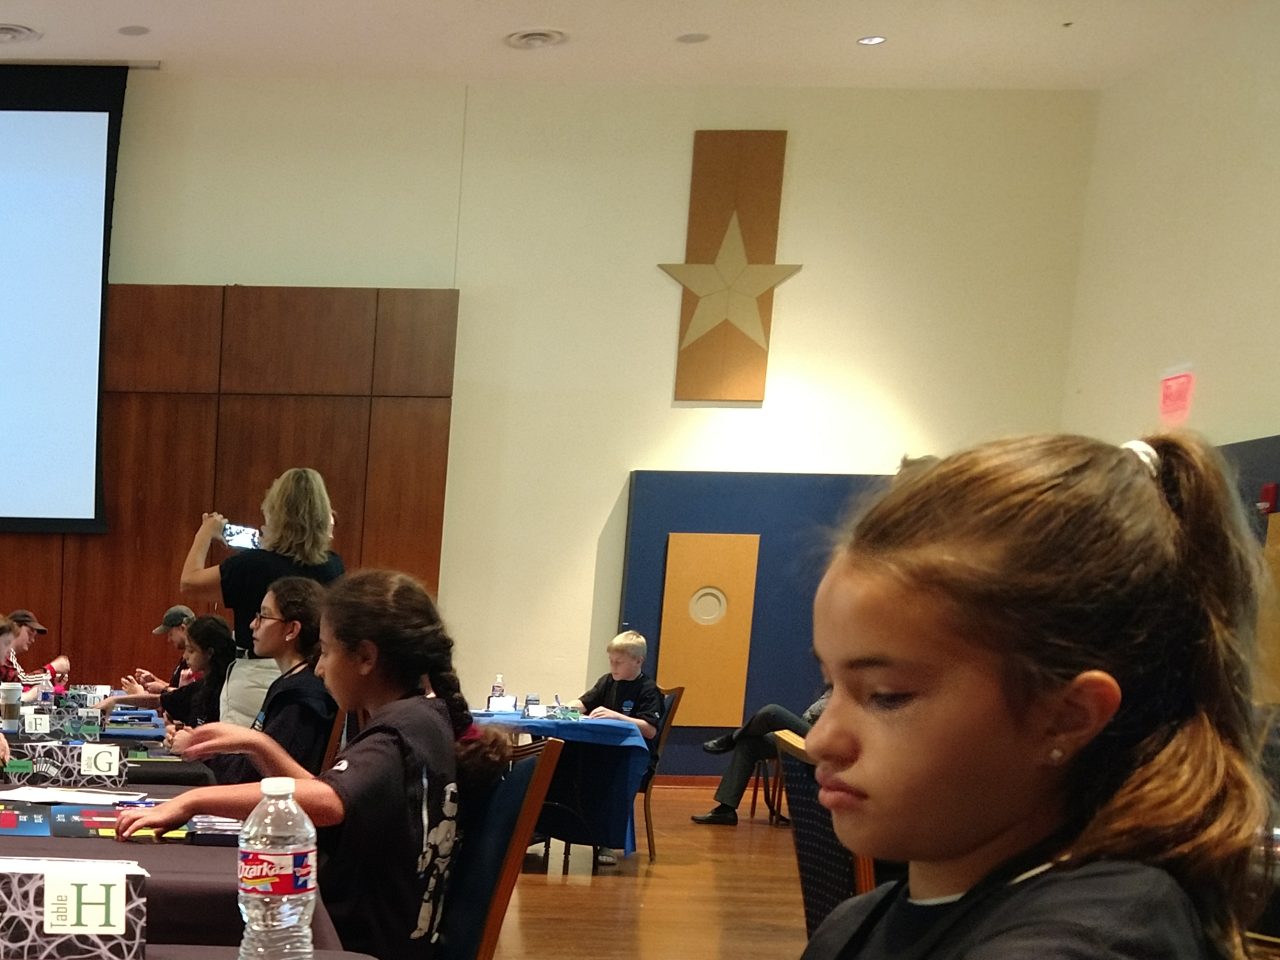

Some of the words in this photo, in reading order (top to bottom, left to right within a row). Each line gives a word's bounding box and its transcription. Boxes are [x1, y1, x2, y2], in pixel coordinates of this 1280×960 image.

[33, 717, 43, 731] F
[93, 750, 113, 773] G
[50, 894, 68, 929] Table
[70, 883, 116, 928] H
